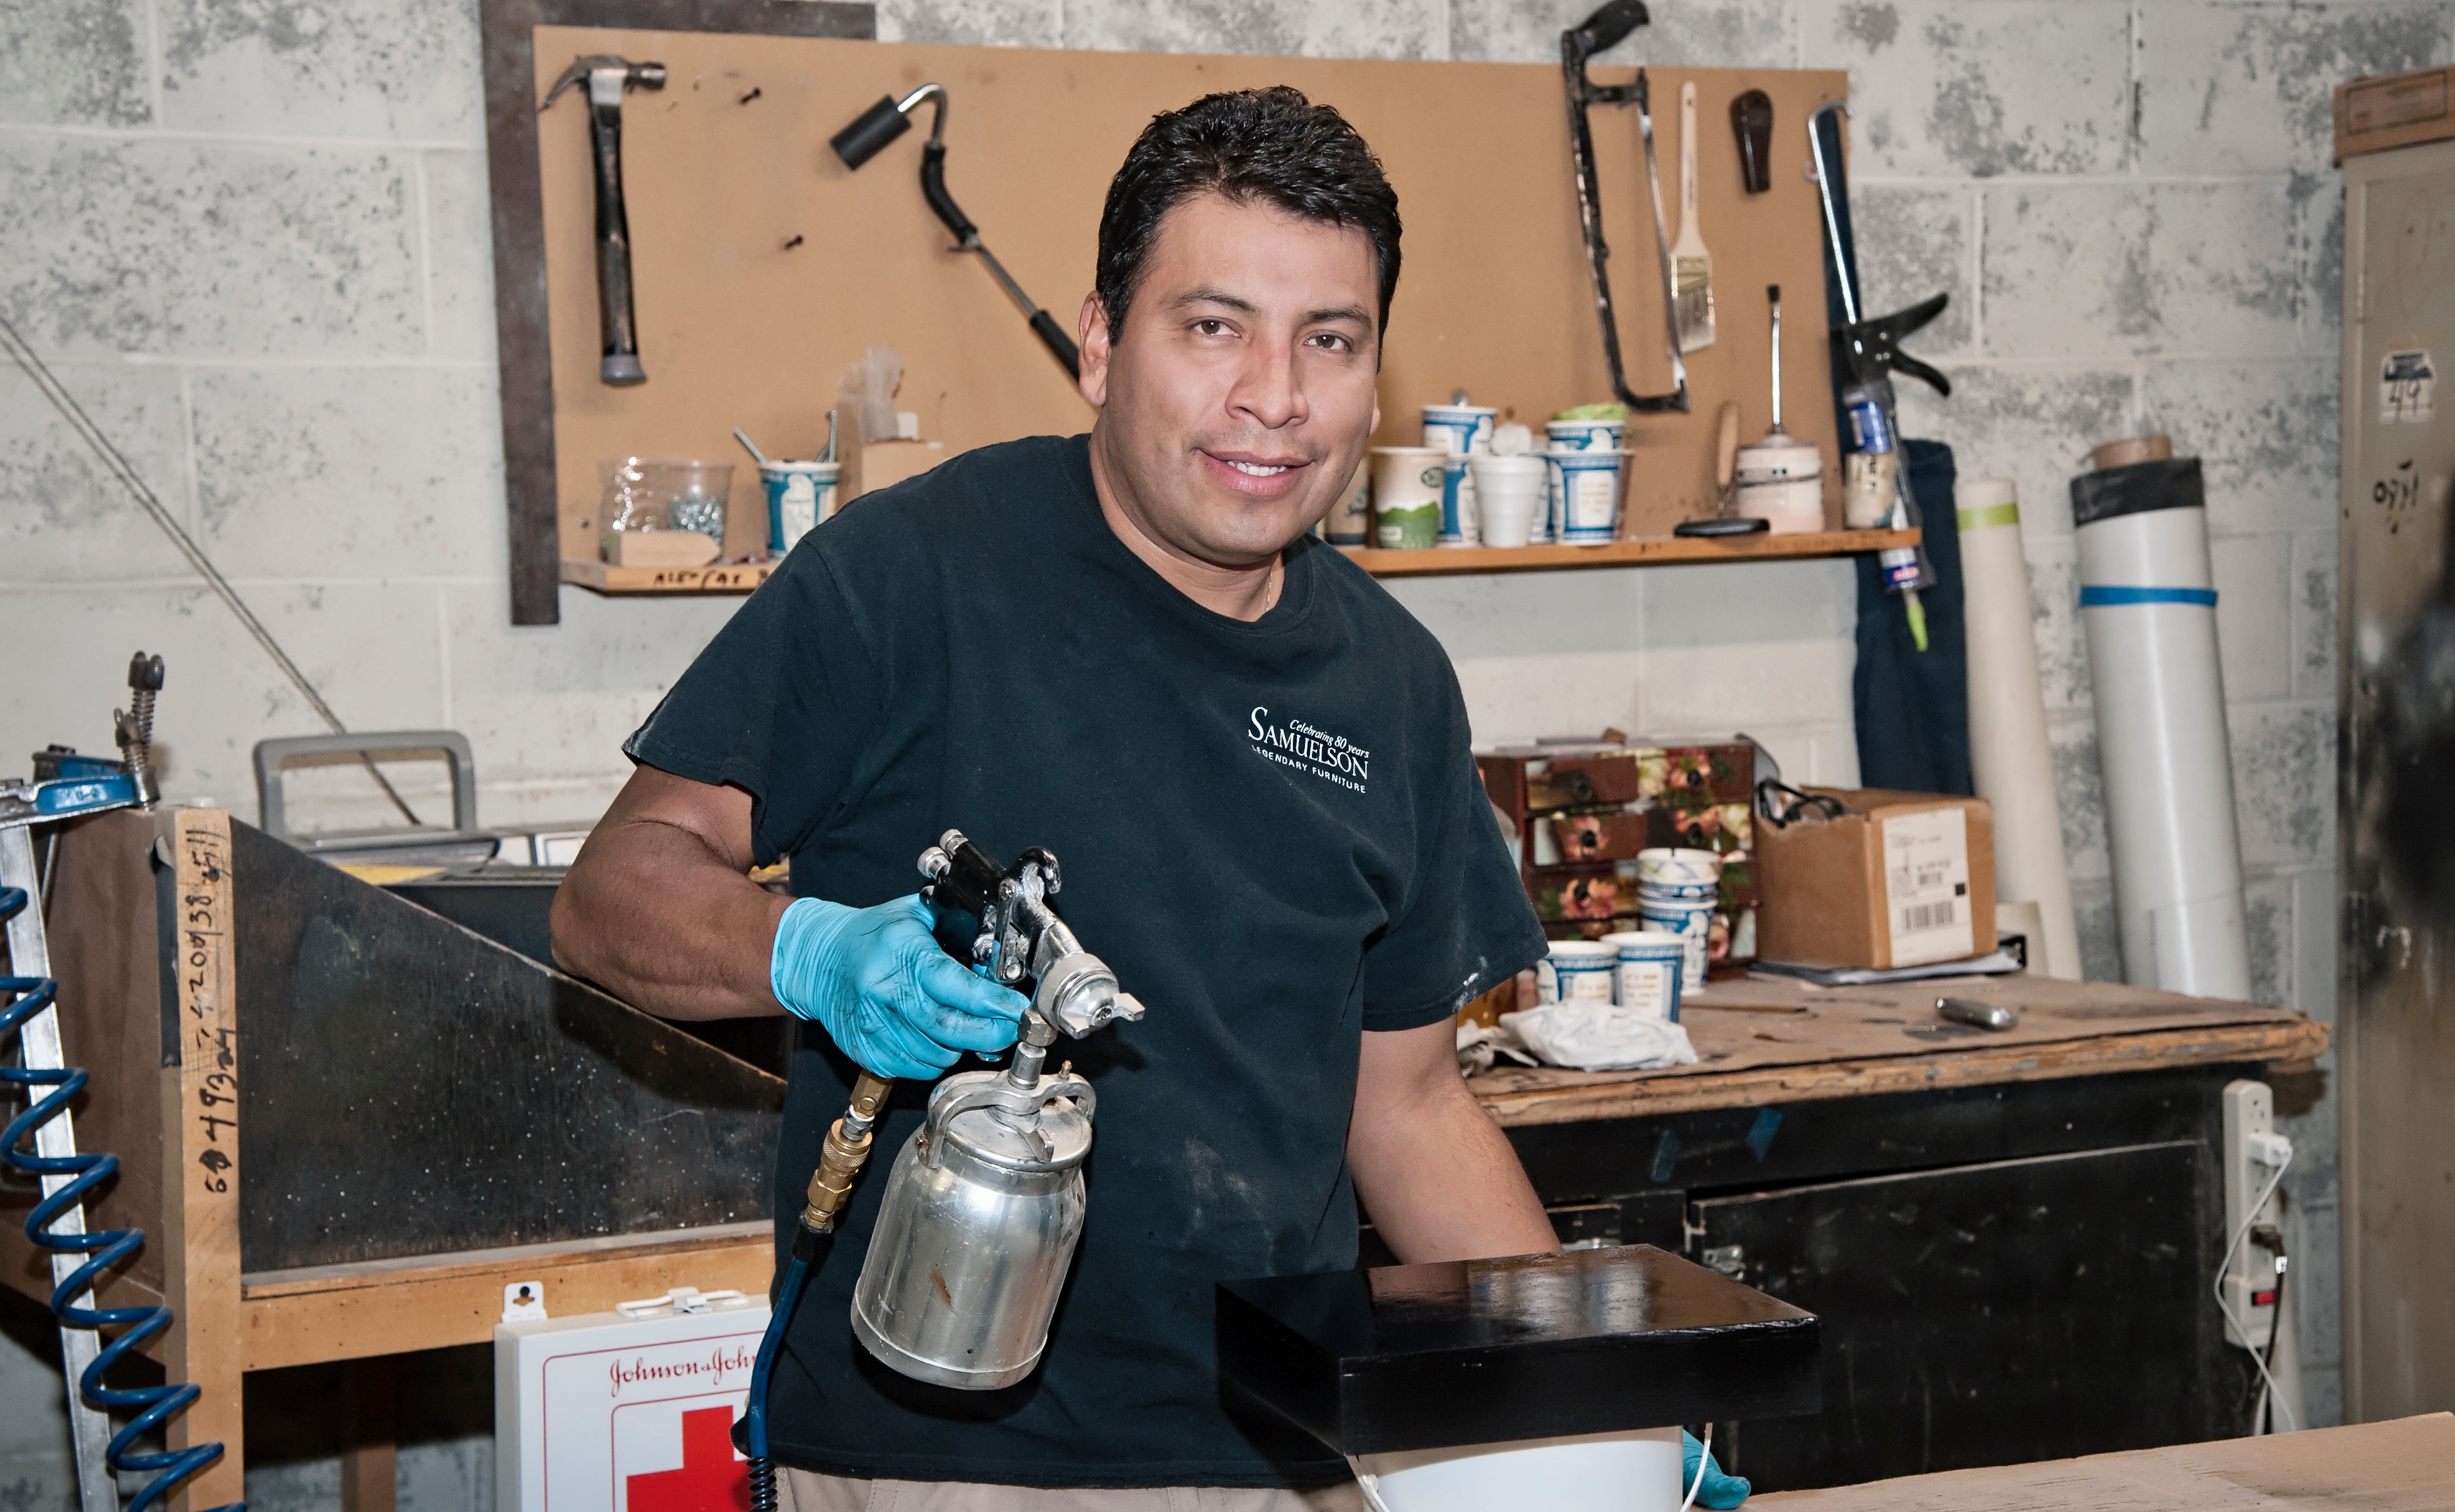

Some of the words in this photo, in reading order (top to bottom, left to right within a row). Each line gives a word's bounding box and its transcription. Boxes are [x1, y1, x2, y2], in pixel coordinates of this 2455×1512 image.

[1289, 719, 1334, 747] Celebrating
[1334, 735, 1347, 749] 80
[1347, 744, 1370, 759] years
[1251, 744, 1308, 772] LEGENDARY
[1312, 766, 1367, 794] FURNITURE
[610, 1358, 698, 1398] Johnson
